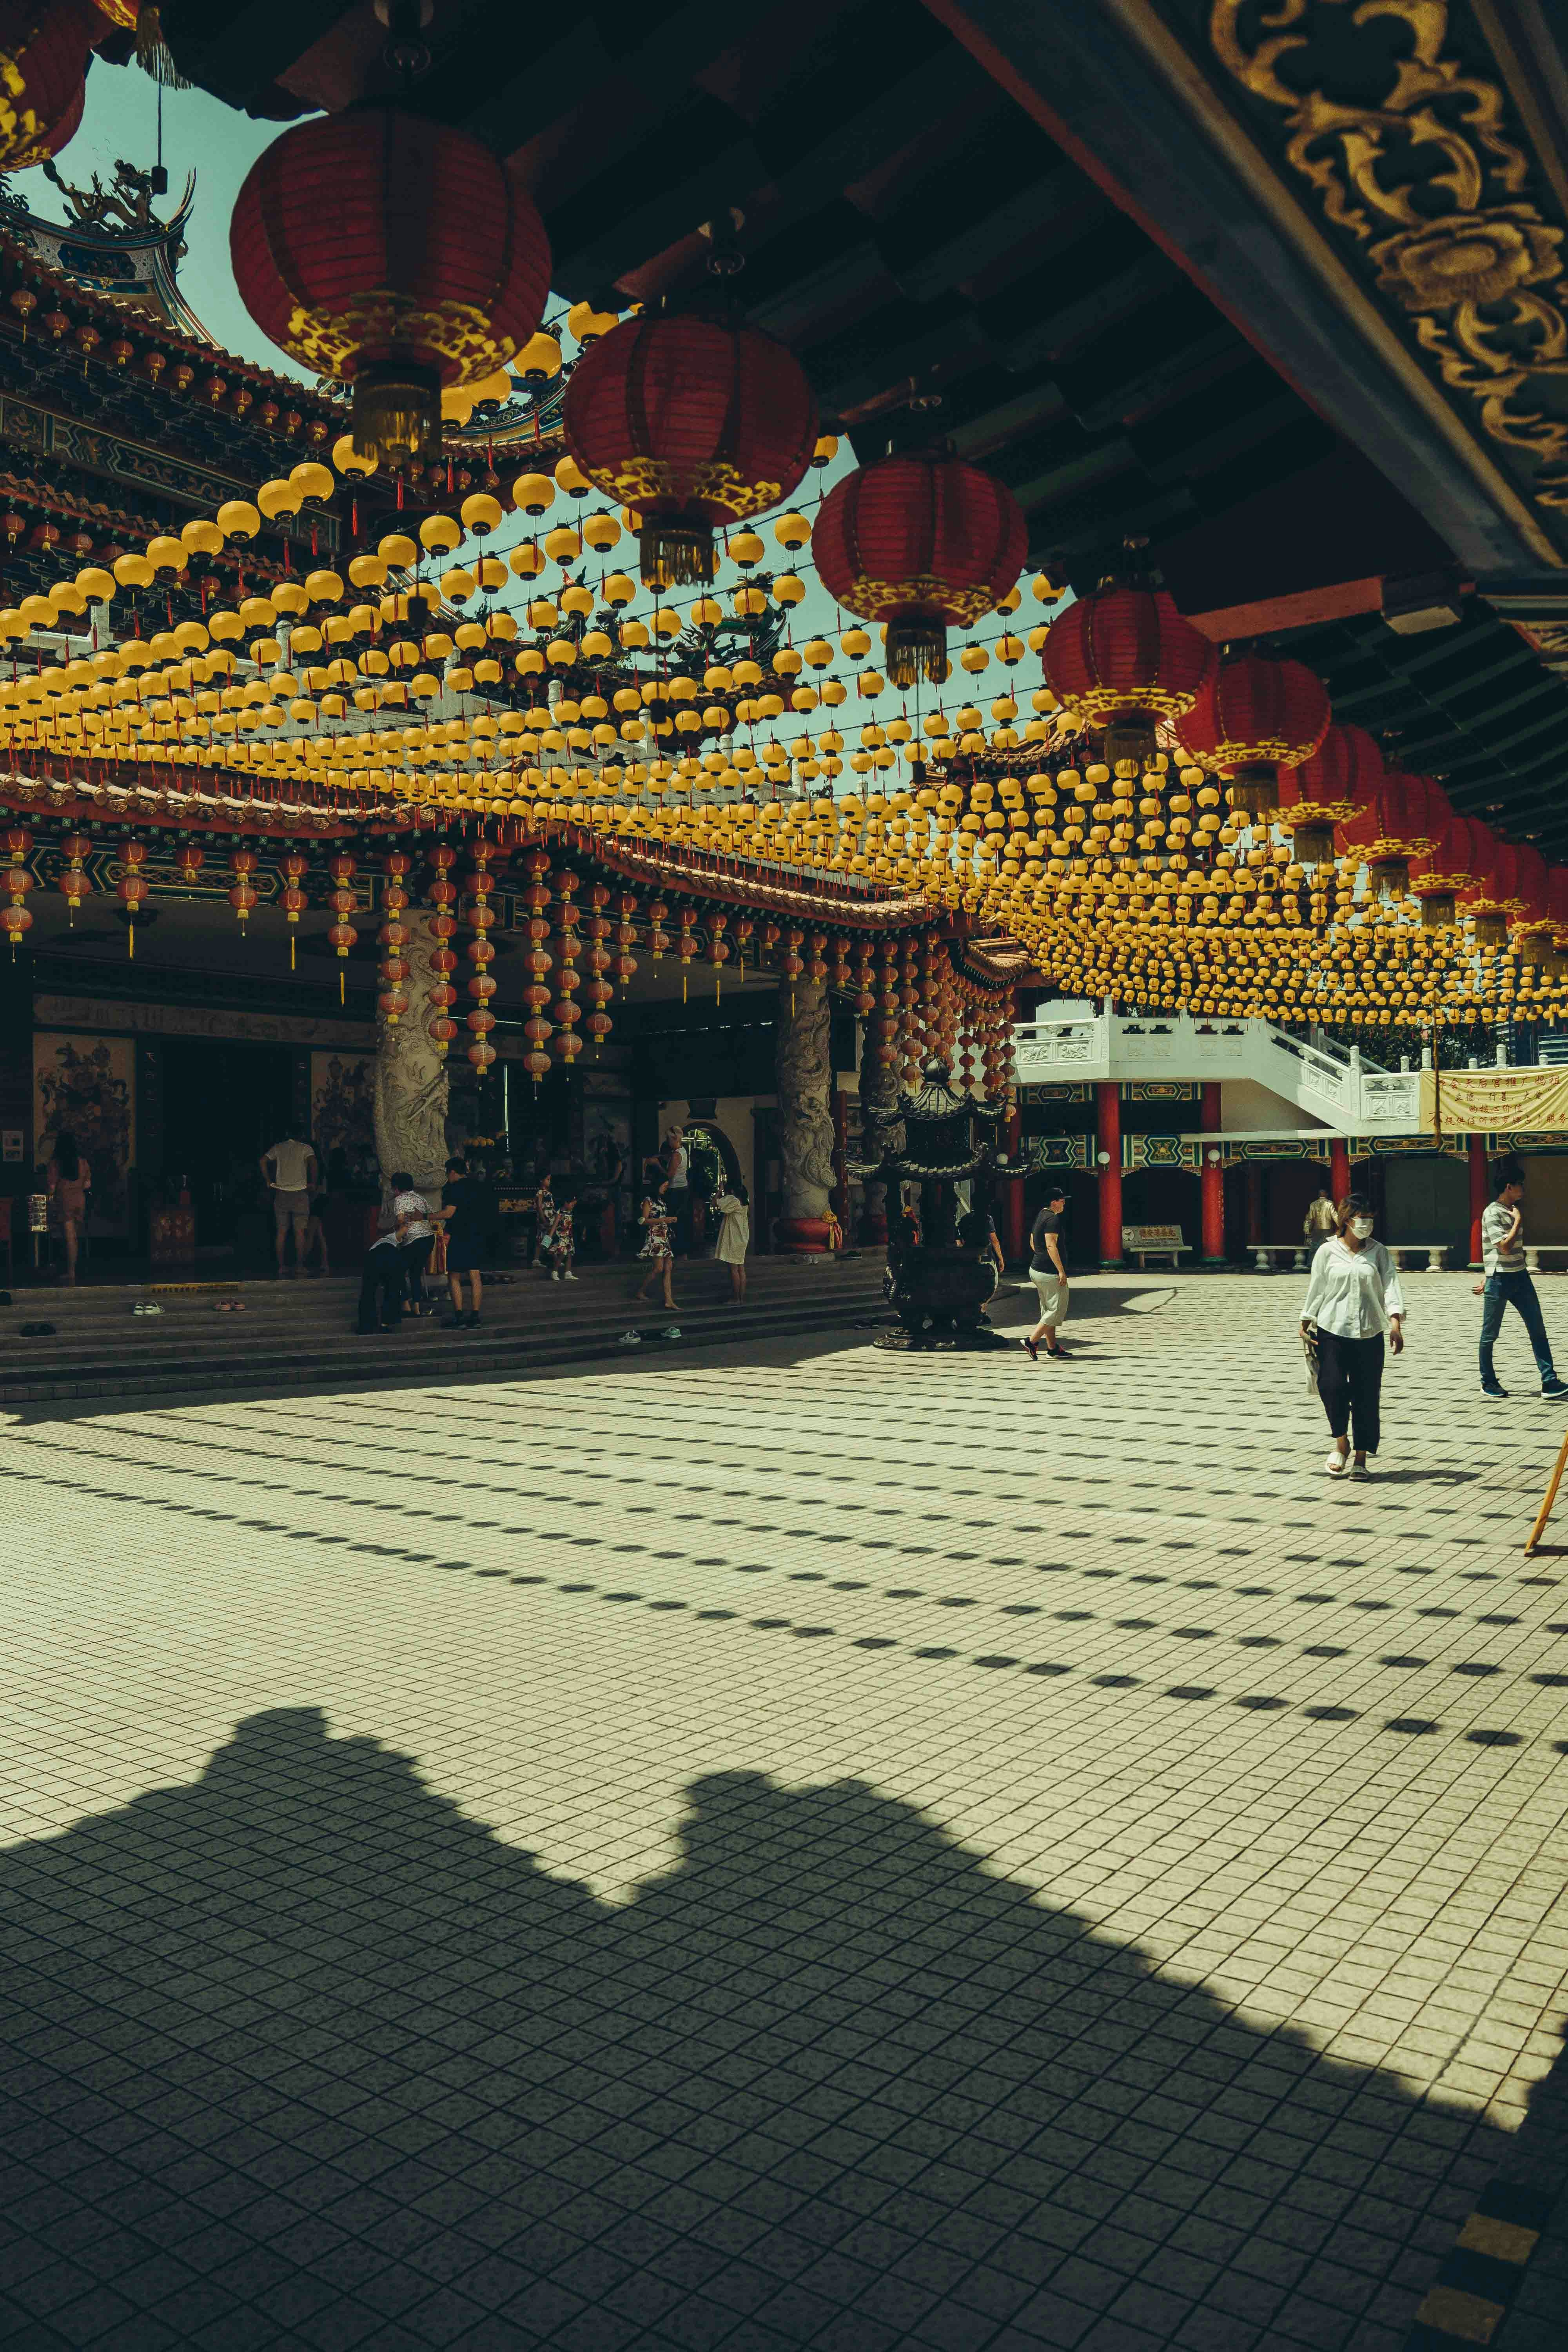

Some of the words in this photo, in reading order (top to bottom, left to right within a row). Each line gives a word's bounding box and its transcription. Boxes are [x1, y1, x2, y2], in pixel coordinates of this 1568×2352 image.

[1469, 1103, 1523, 1113] 的核心价值
